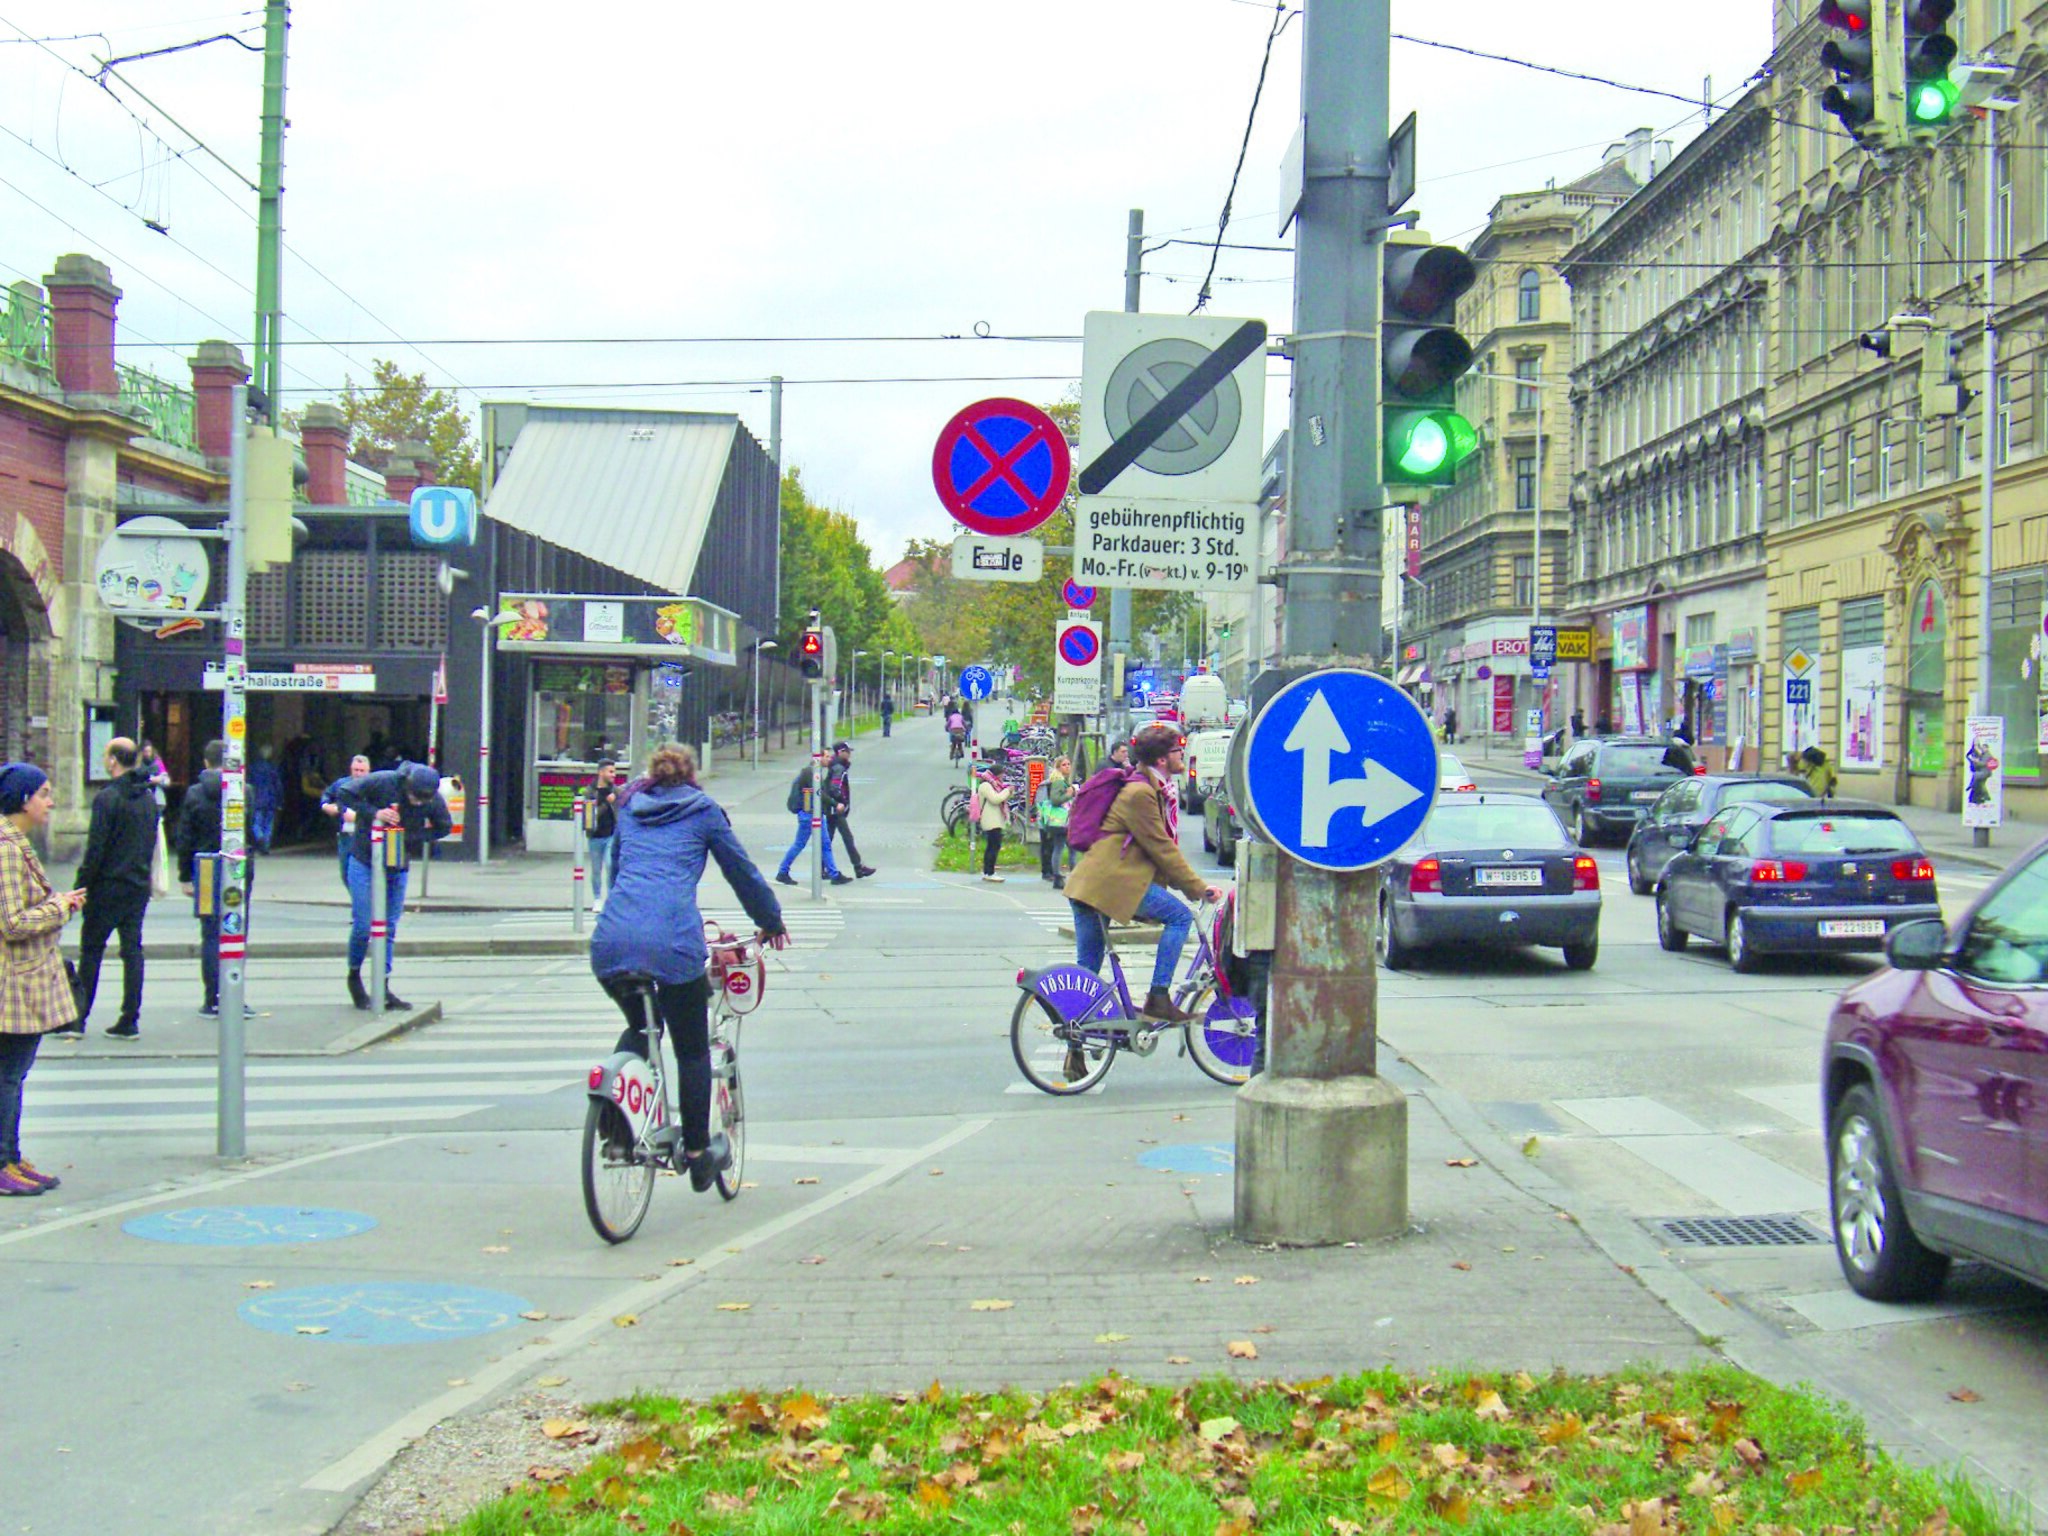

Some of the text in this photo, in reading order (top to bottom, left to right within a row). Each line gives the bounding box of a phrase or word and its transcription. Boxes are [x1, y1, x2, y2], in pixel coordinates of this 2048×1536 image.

[421, 500, 456, 538] U
[1090, 508, 1244, 534] gebührenpflichtig
[1410, 512, 1419, 549] BAR
[1093, 533, 1239, 556] Parkdauer: 3 Std.
[973, 546, 1023, 571] Ede
[1081, 558, 1136, 577] Mo.-Fr.
[1139, 562, 1187, 581] (wkt.)
[1191, 569, 1200, 579] v.
[1558, 640, 1587, 652] VAK
[246, 675, 323, 688] haliastraße
[1789, 684, 1810, 699] 221
